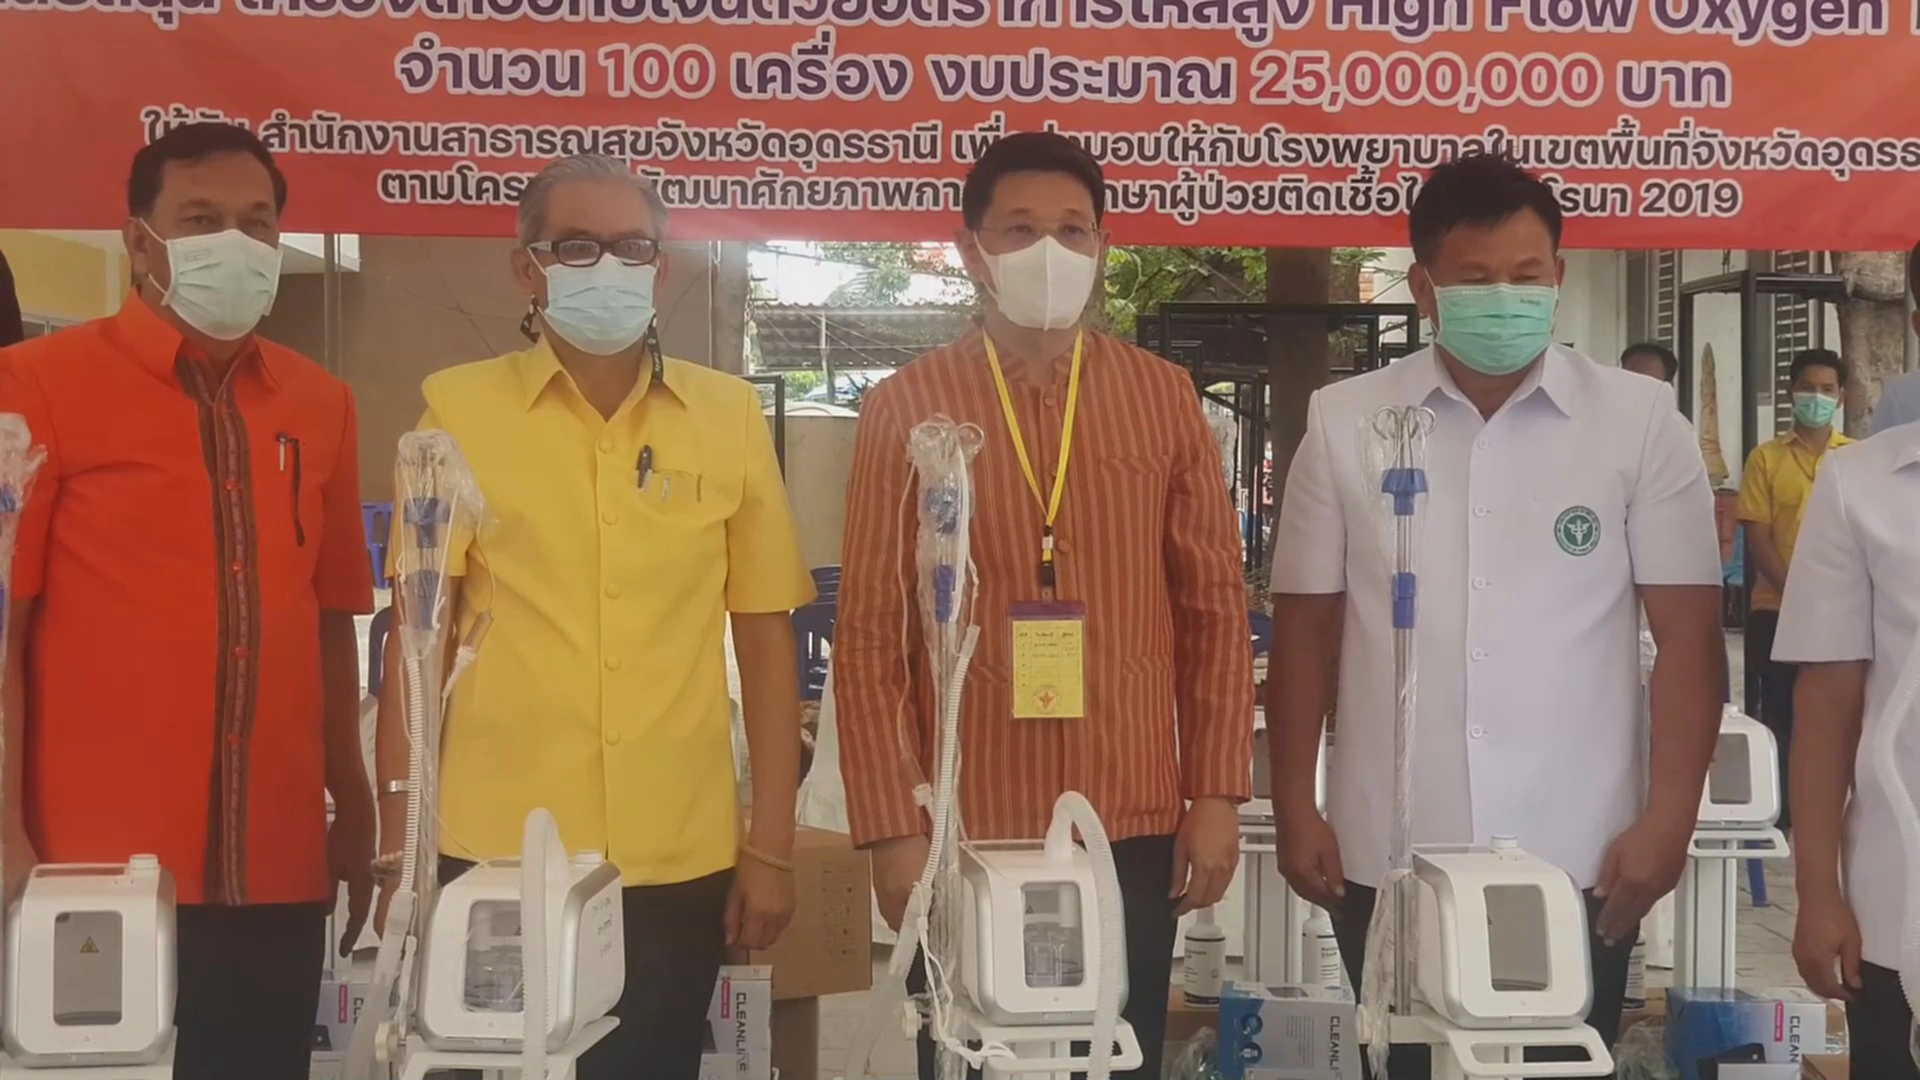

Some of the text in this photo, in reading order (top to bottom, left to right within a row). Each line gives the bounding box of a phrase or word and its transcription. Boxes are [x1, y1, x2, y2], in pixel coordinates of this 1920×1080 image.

[398, 30, 1727, 107] จำนวน 100 เครื่อง งบประมาณ 25,000,000 บาท
[1642, 182, 1739, 214] 2019
